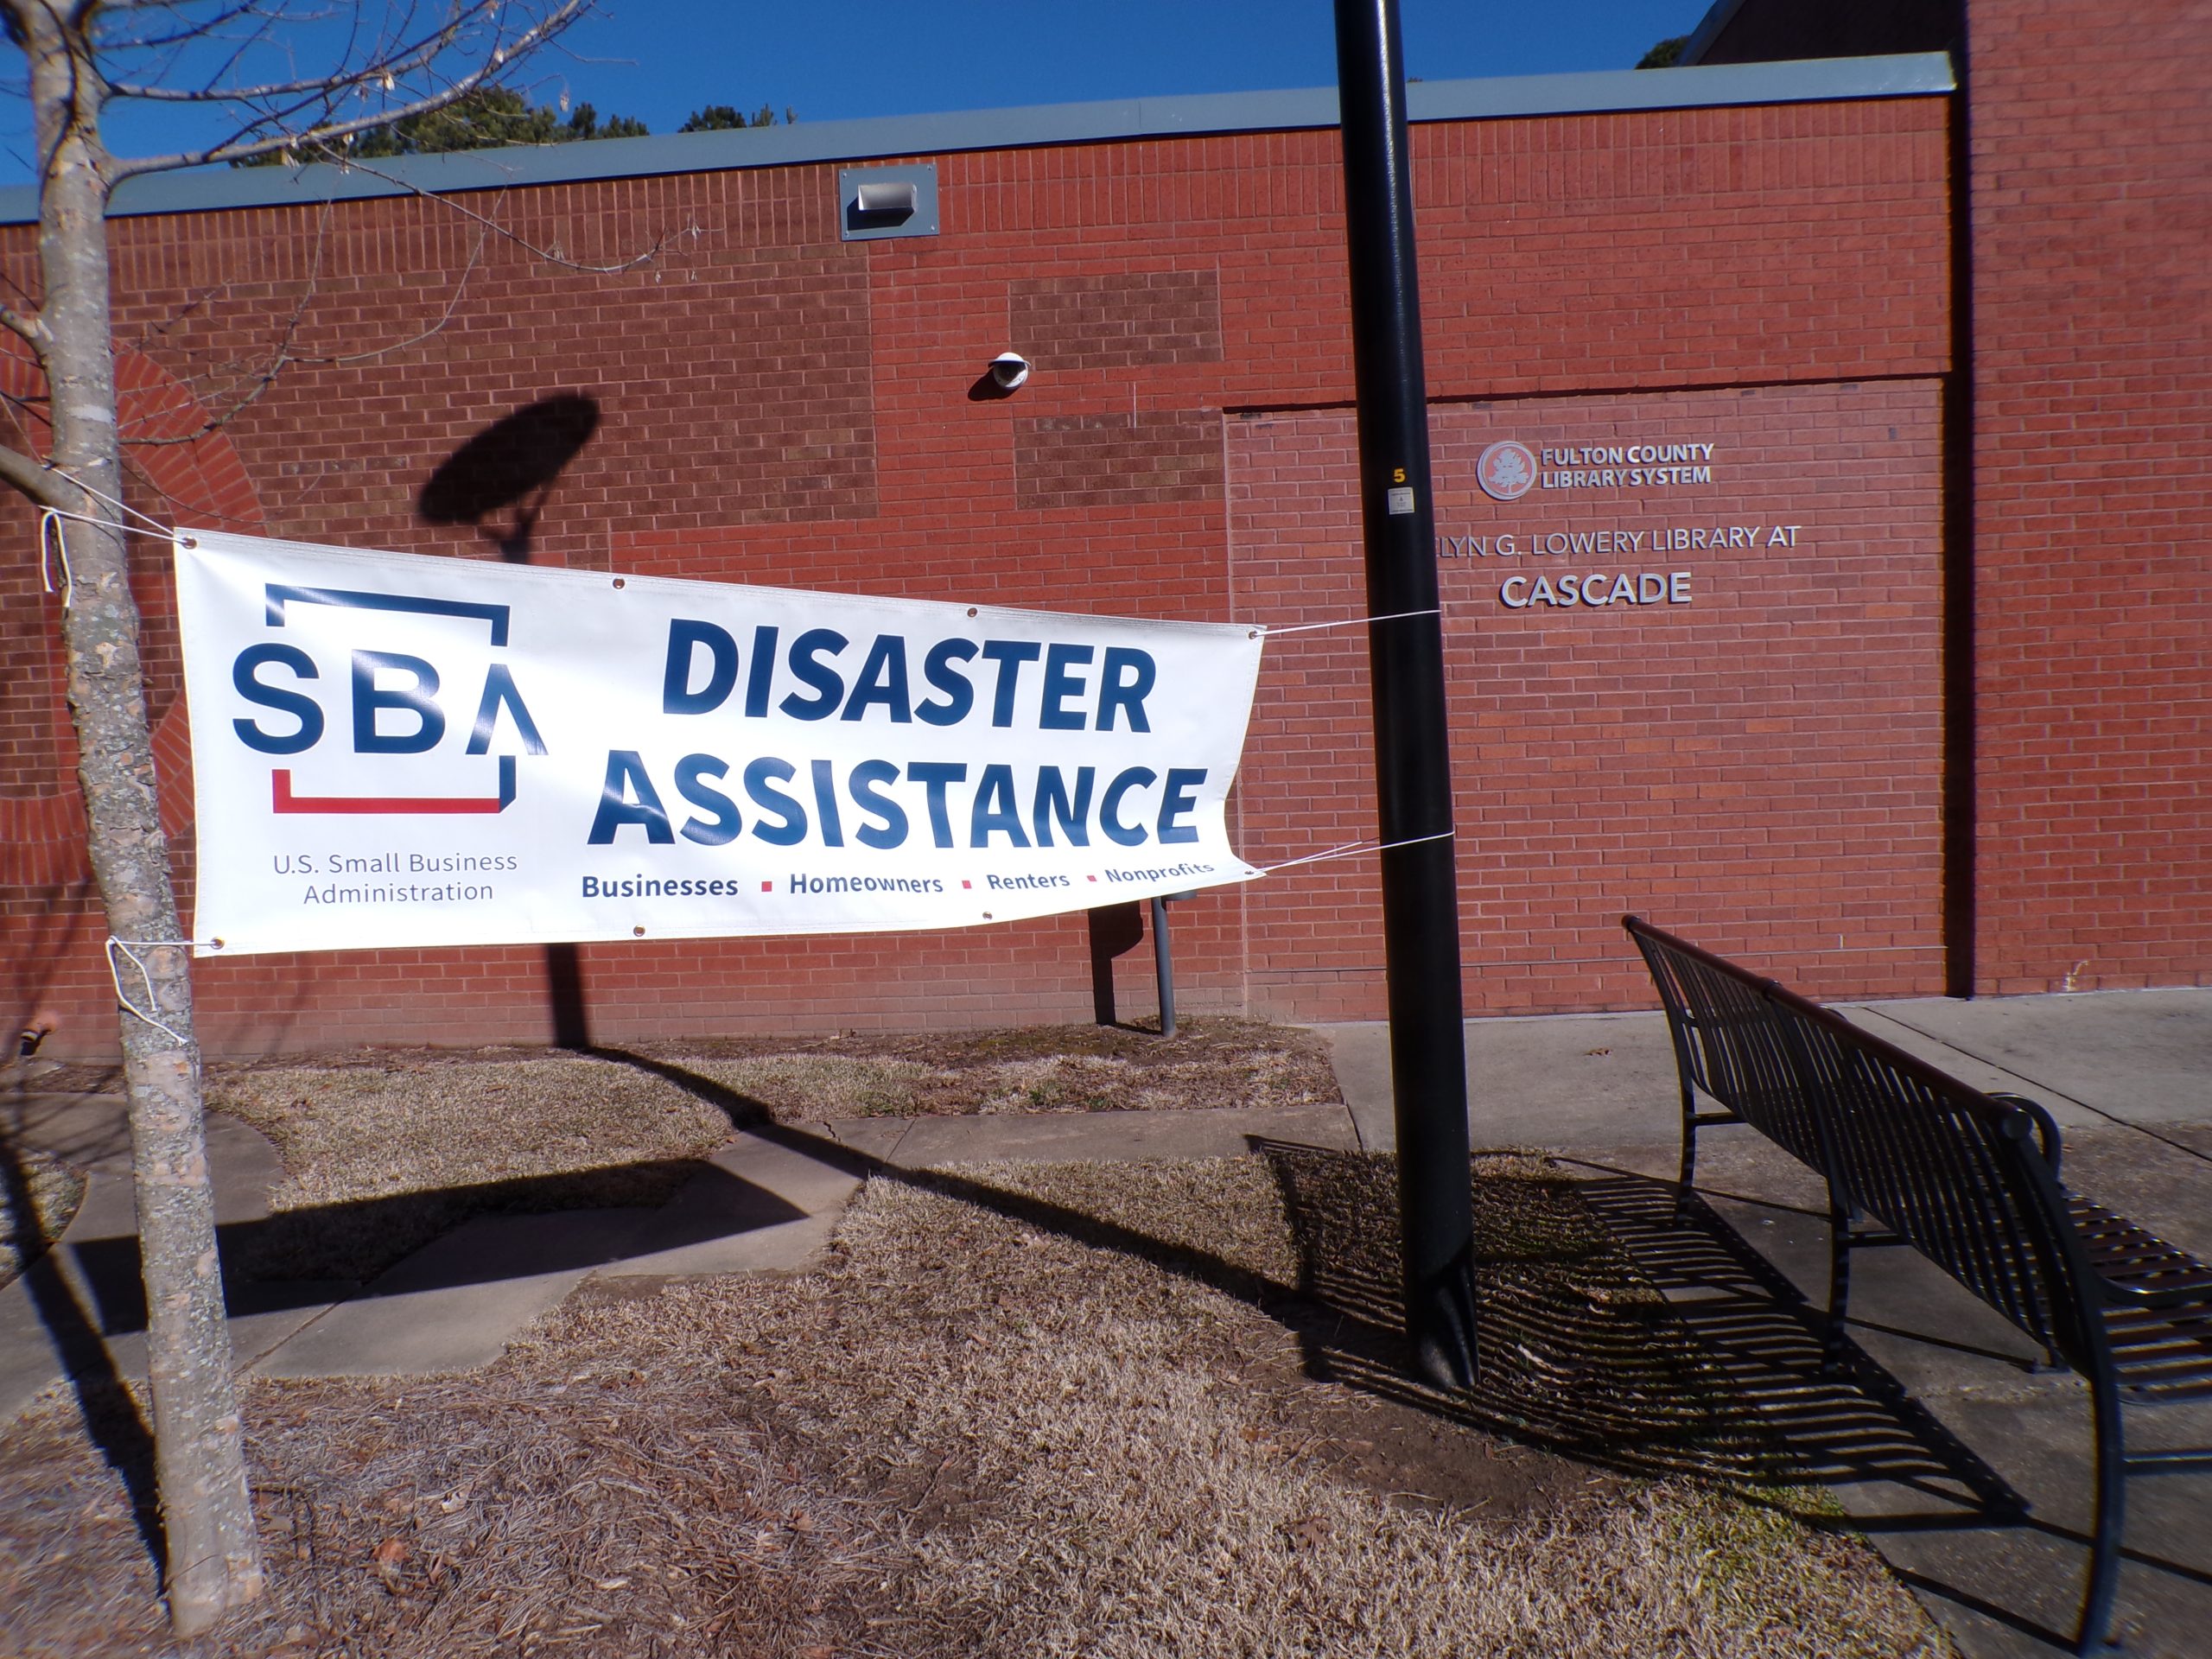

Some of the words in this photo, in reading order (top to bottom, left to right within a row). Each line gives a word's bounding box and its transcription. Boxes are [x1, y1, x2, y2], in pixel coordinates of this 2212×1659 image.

[1541, 447, 1623, 467] FULTON
[1625, 443, 1714, 464] COUNTY
[1394, 468, 1406, 482] 5
[1541, 469, 1627, 488] LIBRARY
[1628, 466, 1711, 486] SYSTEM
[1495, 534, 1522, 556] G.
[1531, 531, 1644, 556] LOWERY
[1651, 526, 1760, 551] LIBRARY
[1767, 525, 1802, 548] AT
[1500, 572, 1693, 607] CASCADE
[663, 617, 1157, 734] DISASTER
[232, 642, 550, 756] SBA
[587, 749, 1209, 849] ASSISTANCE
[273, 855, 320, 874] U.S.
[328, 852, 400, 874] Small
[410, 853, 518, 873] Business
[303, 881, 493, 905] Administration
[582, 874, 739, 898] Businesses
[790, 873, 944, 894] Homeowners
[987, 873, 1071, 890] Renters
[1104, 862, 1215, 884] Nonprofits
